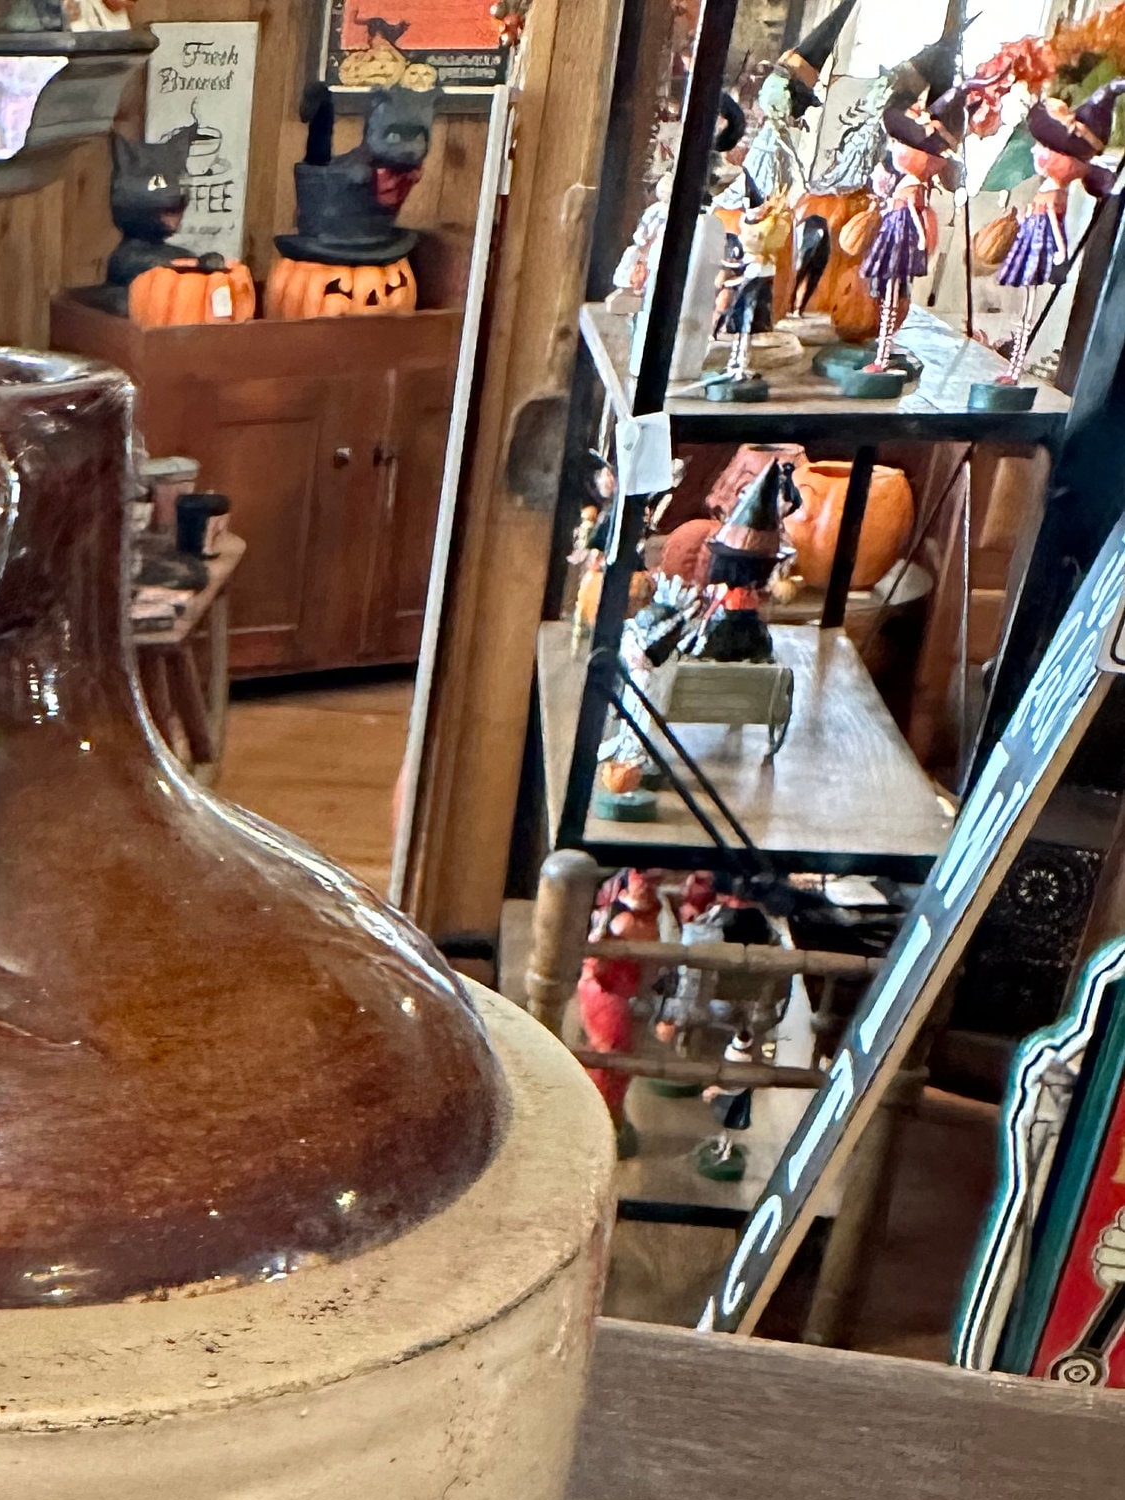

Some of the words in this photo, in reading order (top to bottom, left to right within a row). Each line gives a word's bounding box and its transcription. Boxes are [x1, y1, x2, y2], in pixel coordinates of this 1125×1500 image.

[158, 67, 234, 94] Brewed
[182, 41, 239, 68] Fresh
[1011, 611, 1098, 755] fall
[696, 741, 1024, 1332] WITC
